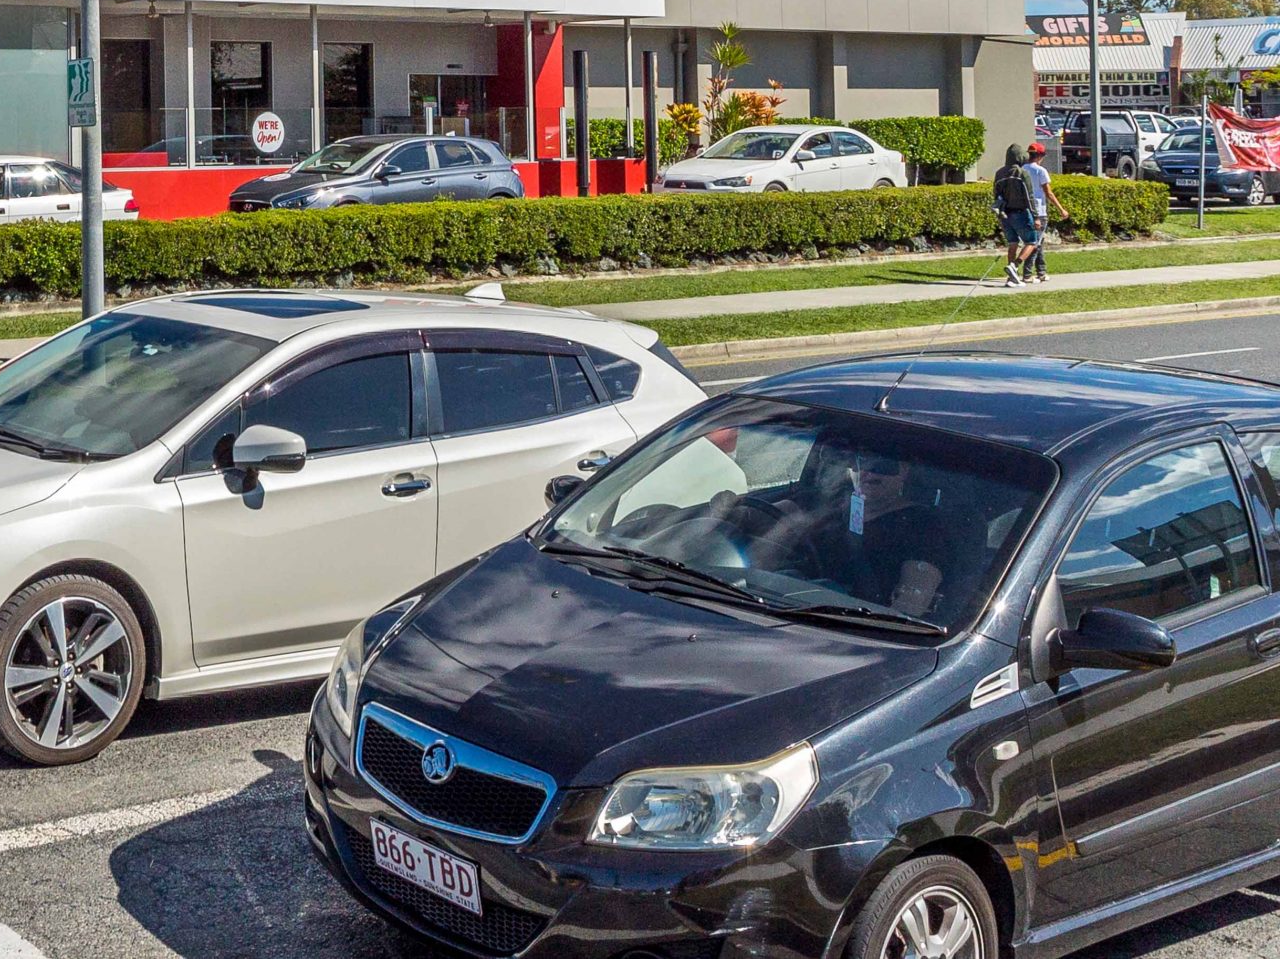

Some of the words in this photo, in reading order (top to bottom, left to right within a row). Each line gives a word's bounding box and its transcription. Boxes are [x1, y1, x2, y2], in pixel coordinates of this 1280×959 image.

[1106, 72, 1124, 81] HIM
[1128, 72, 1134, 80] &
[1140, 72, 1155, 80] HER
[258, 120, 279, 130] WE'RE
[256, 130, 282, 148] Open!
